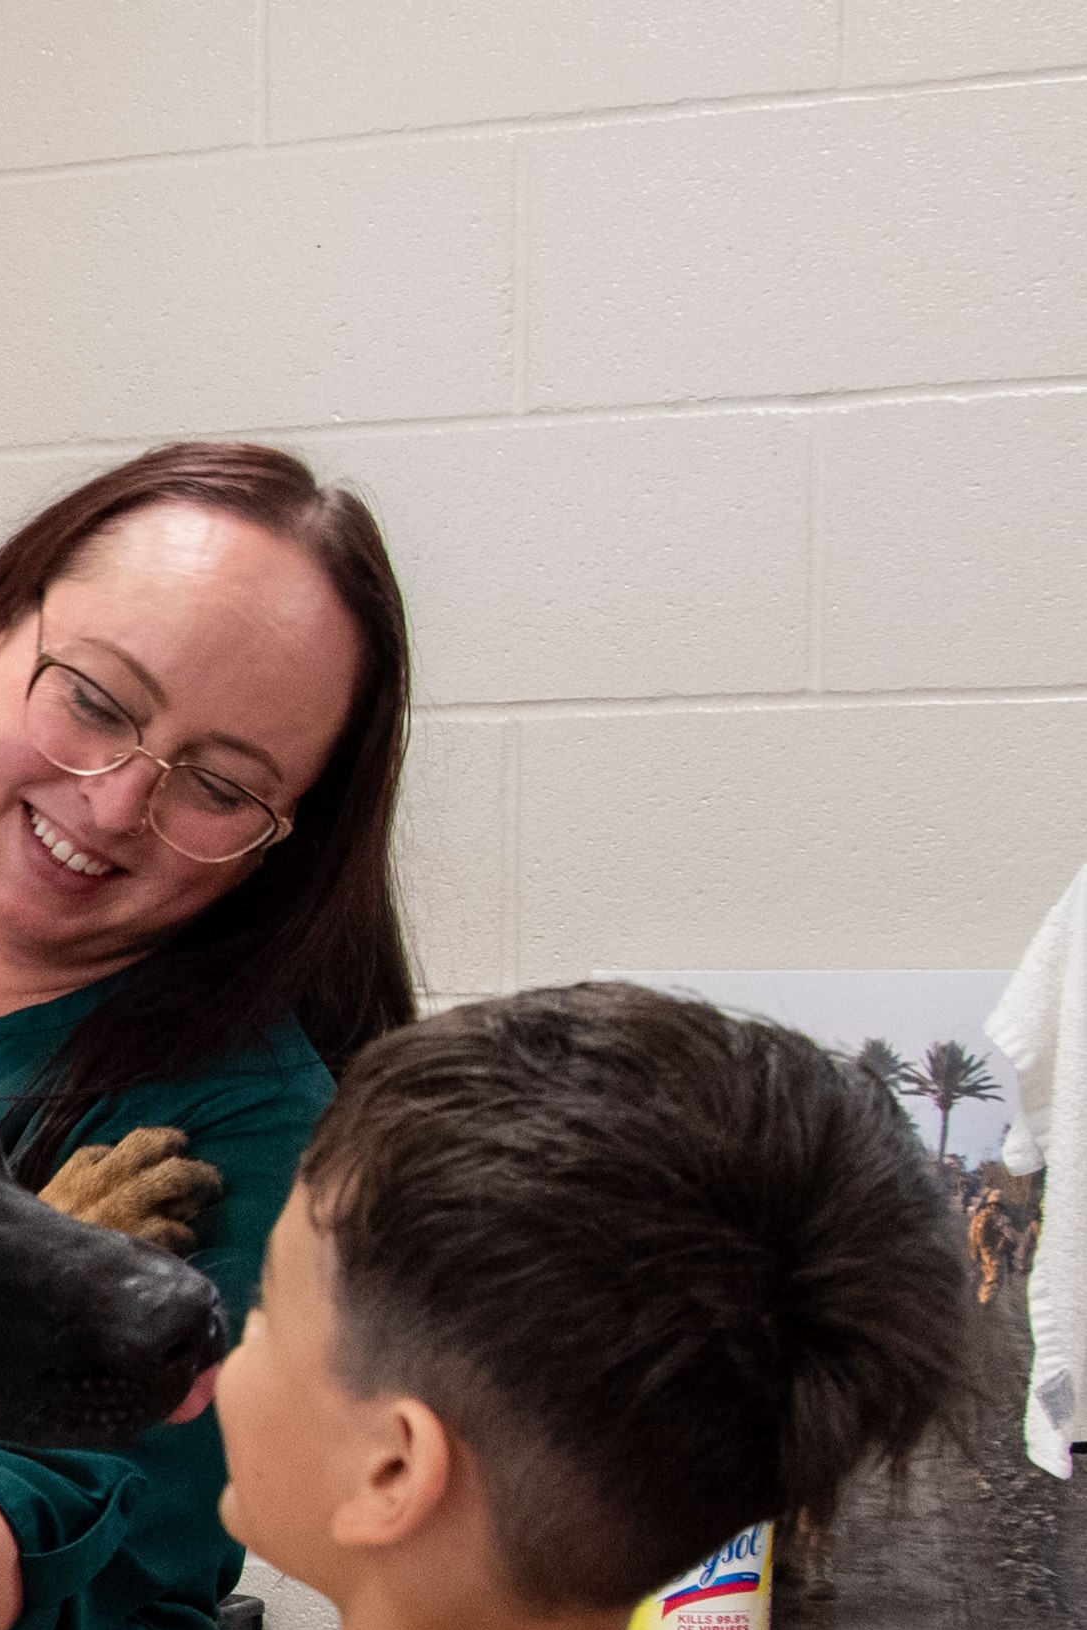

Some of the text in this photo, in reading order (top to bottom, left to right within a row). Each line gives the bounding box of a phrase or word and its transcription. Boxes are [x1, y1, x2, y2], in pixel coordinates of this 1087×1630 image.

[685, 1523, 762, 1586] ysol
[678, 1615, 750, 1624] KILLS 99.9%
